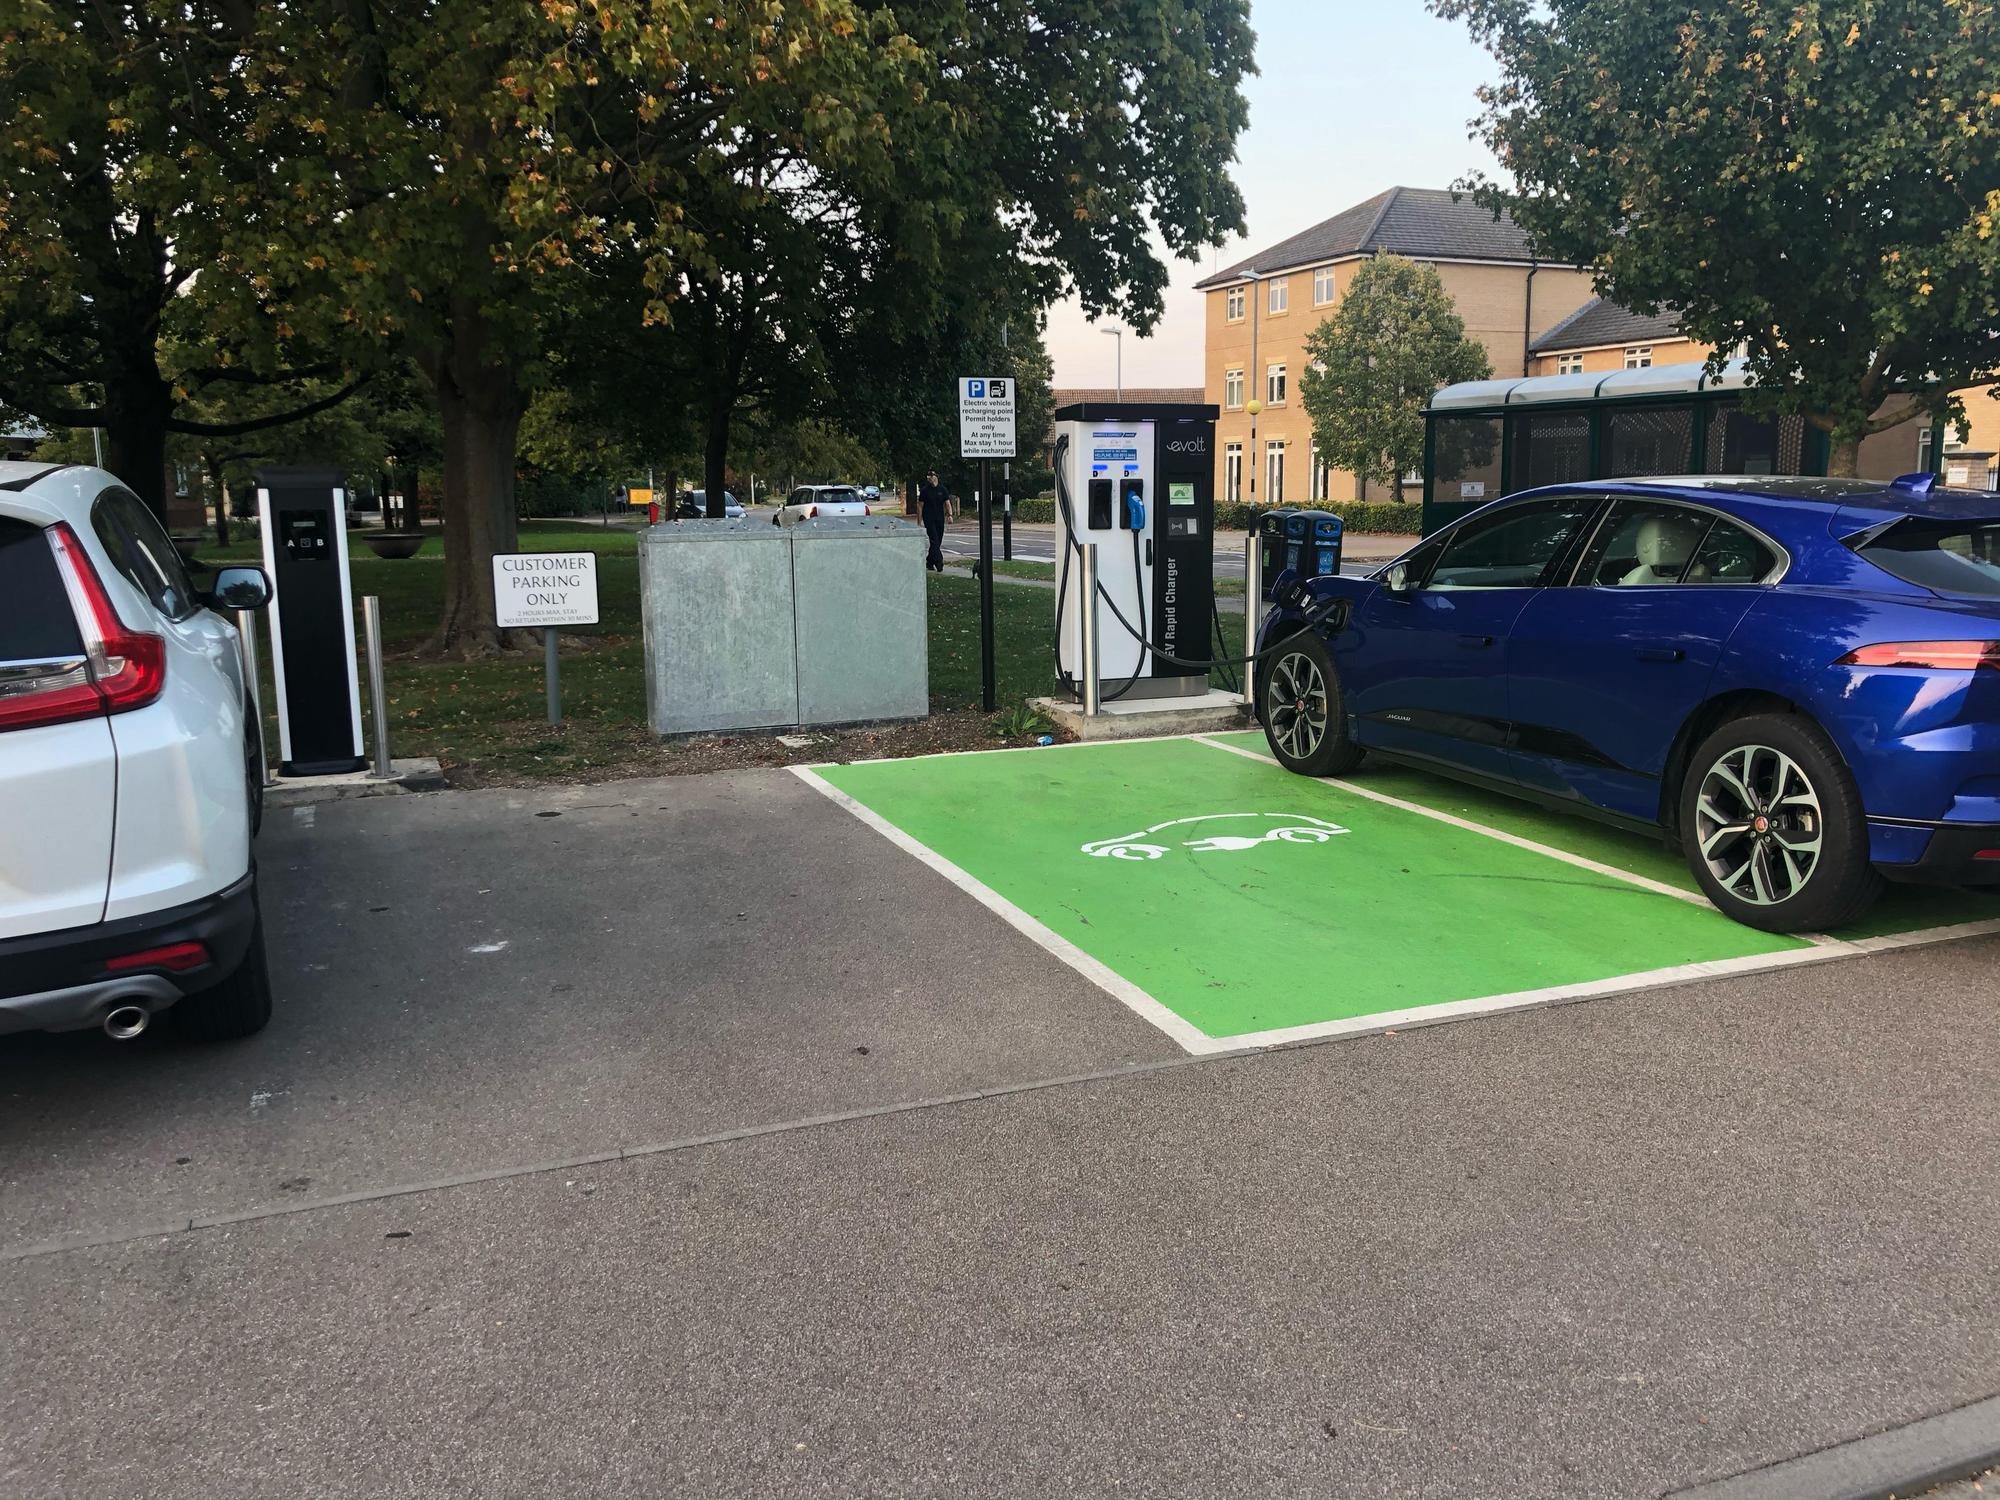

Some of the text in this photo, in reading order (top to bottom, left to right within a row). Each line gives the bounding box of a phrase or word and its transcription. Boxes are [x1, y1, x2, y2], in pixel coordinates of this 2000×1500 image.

[972, 381, 981, 396] P
[1166, 435, 1206, 452] evolt
[287, 539, 295, 547] A
[316, 538, 324, 546] B
[502, 558, 588, 572] CUSTOMER
[512, 575, 580, 588] PARKING
[526, 593, 568, 605] ONLY
[1165, 557, 1178, 657] EV Rapid Charger
